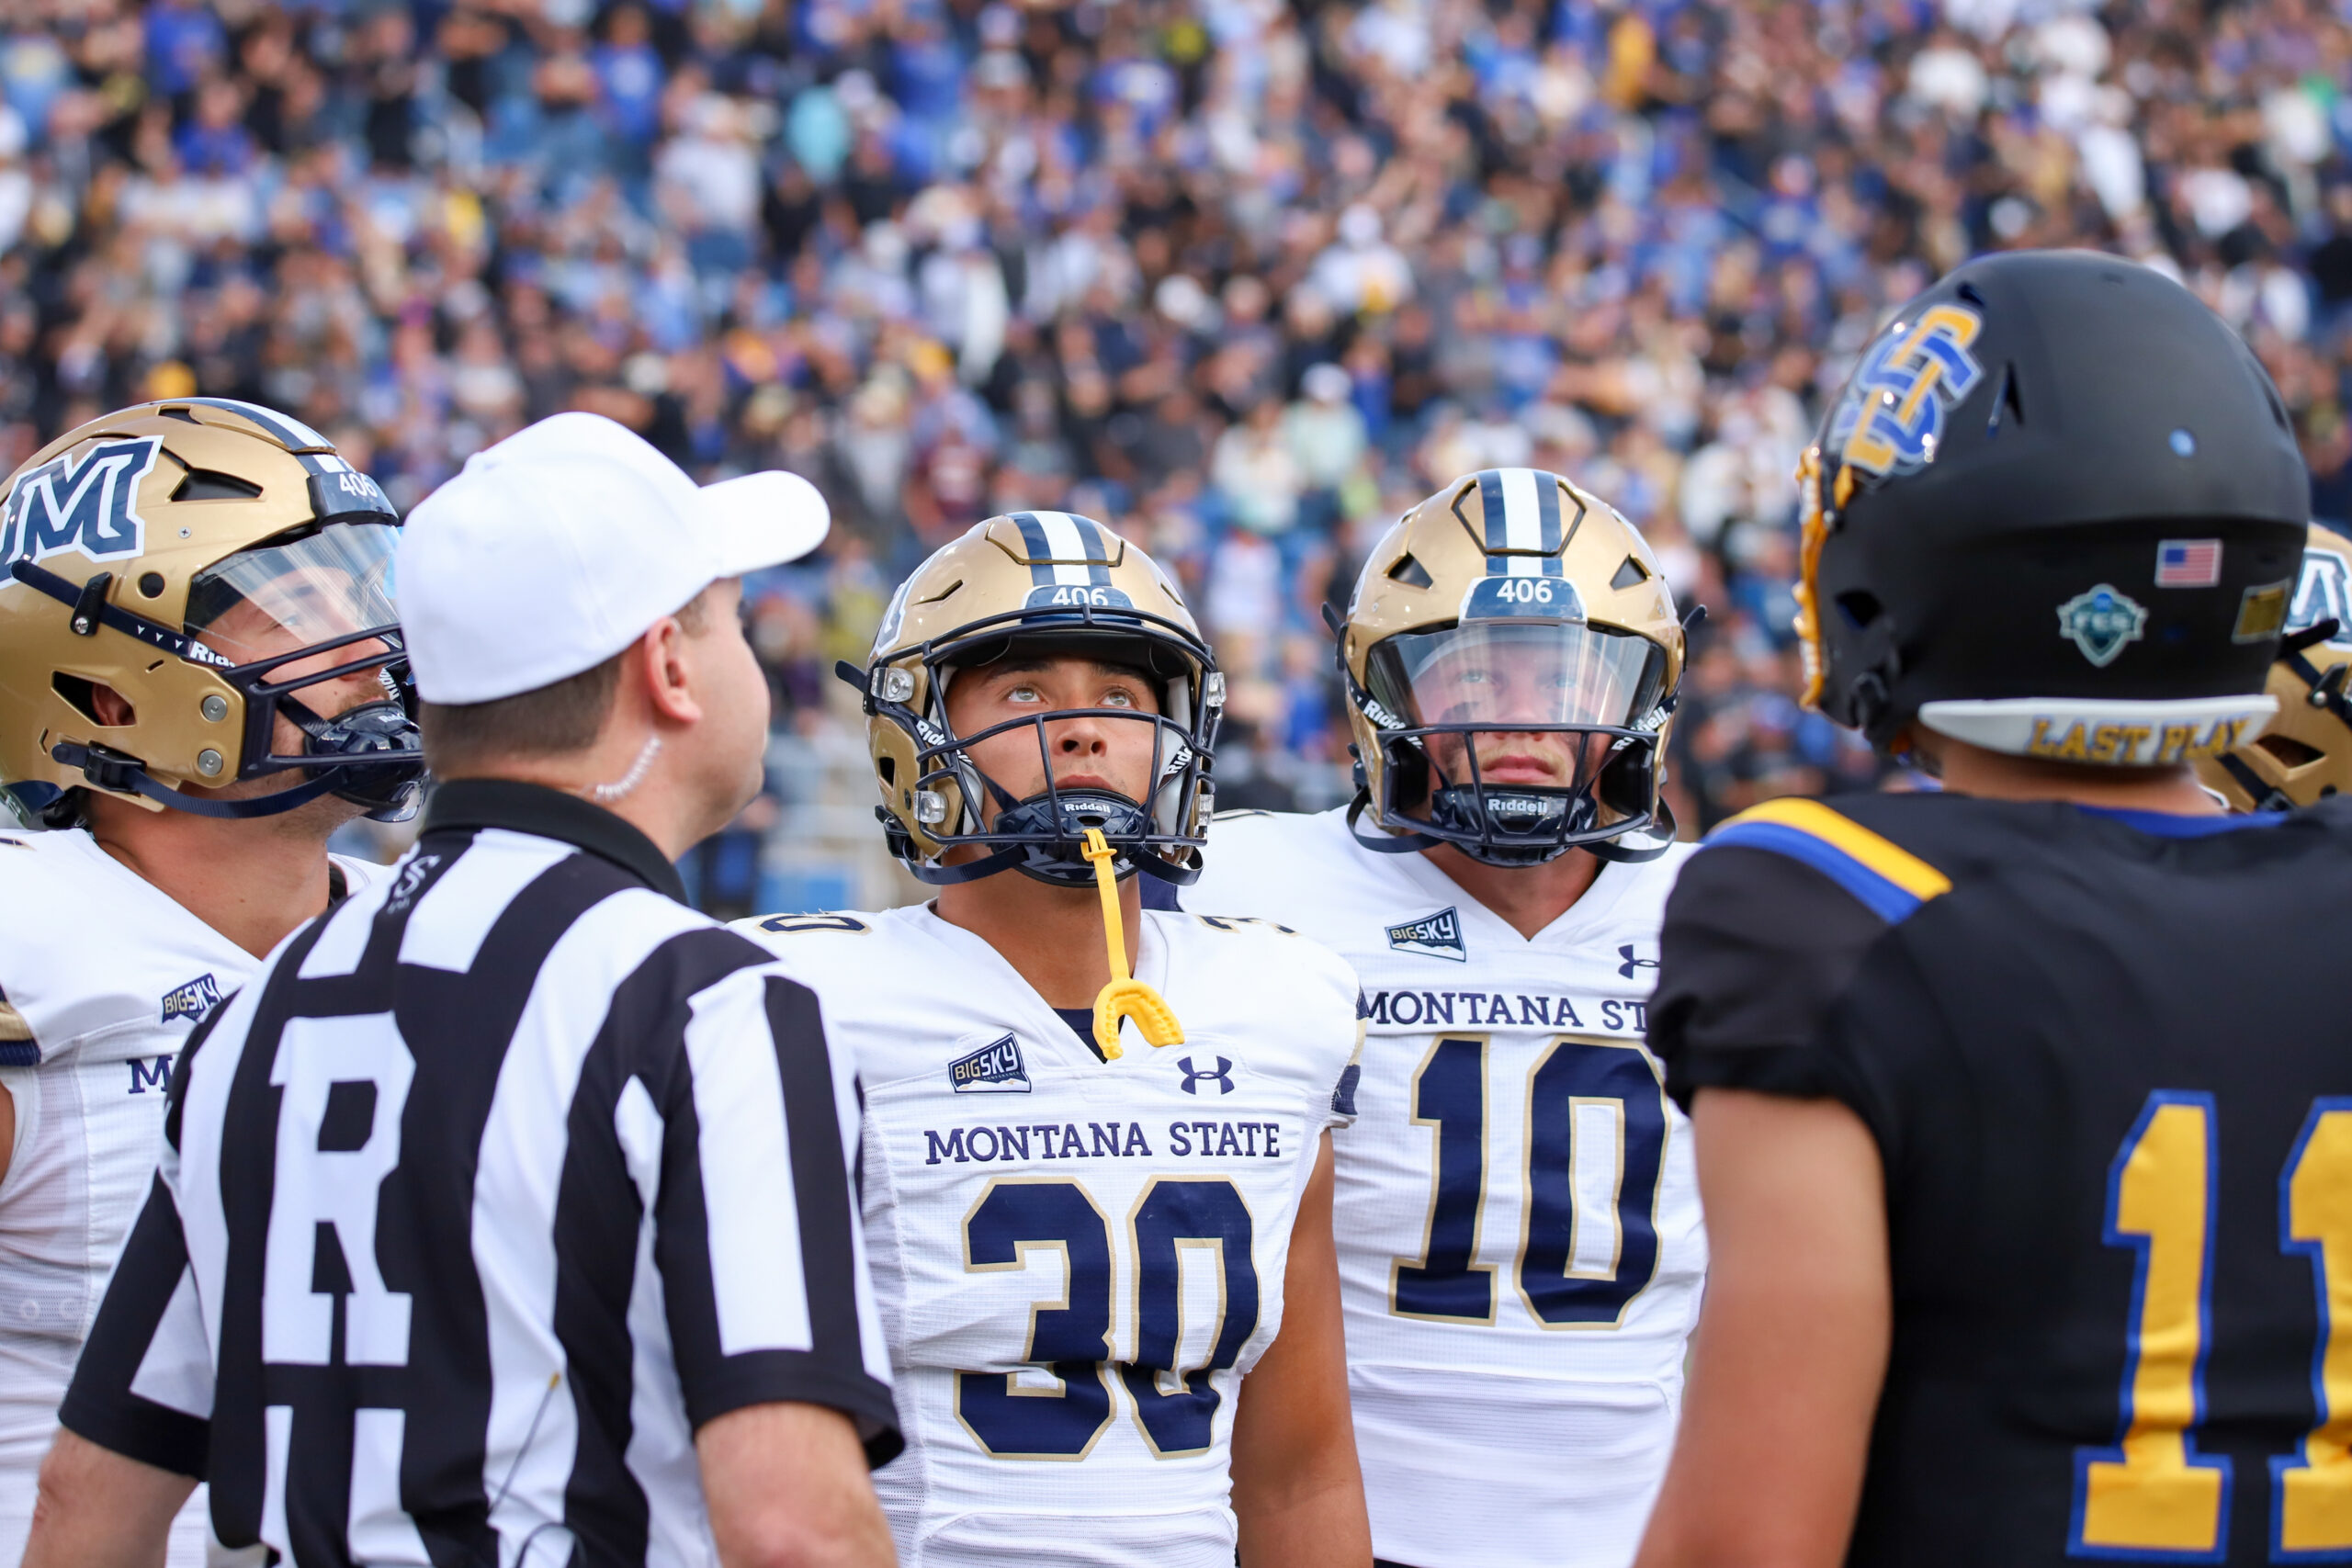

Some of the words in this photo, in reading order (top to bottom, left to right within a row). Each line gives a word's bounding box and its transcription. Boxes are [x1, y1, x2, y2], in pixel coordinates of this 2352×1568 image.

[338, 472, 379, 498] 406
[1052, 586, 1109, 606] 406
[1497, 579, 1553, 604] 406
[2023, 713, 2153, 764] LAST
[2154, 710, 2252, 761] PLAY
[1064, 802, 1111, 814] Riddell
[1487, 798, 1548, 813] Riddell
[923, 1122, 1152, 1165] MONTANA
[1169, 1122, 1280, 1158] STATE
[263, 1012, 417, 1367] R
[1388, 1032, 1672, 1331] 10
[953, 1174, 1262, 1461] 30
